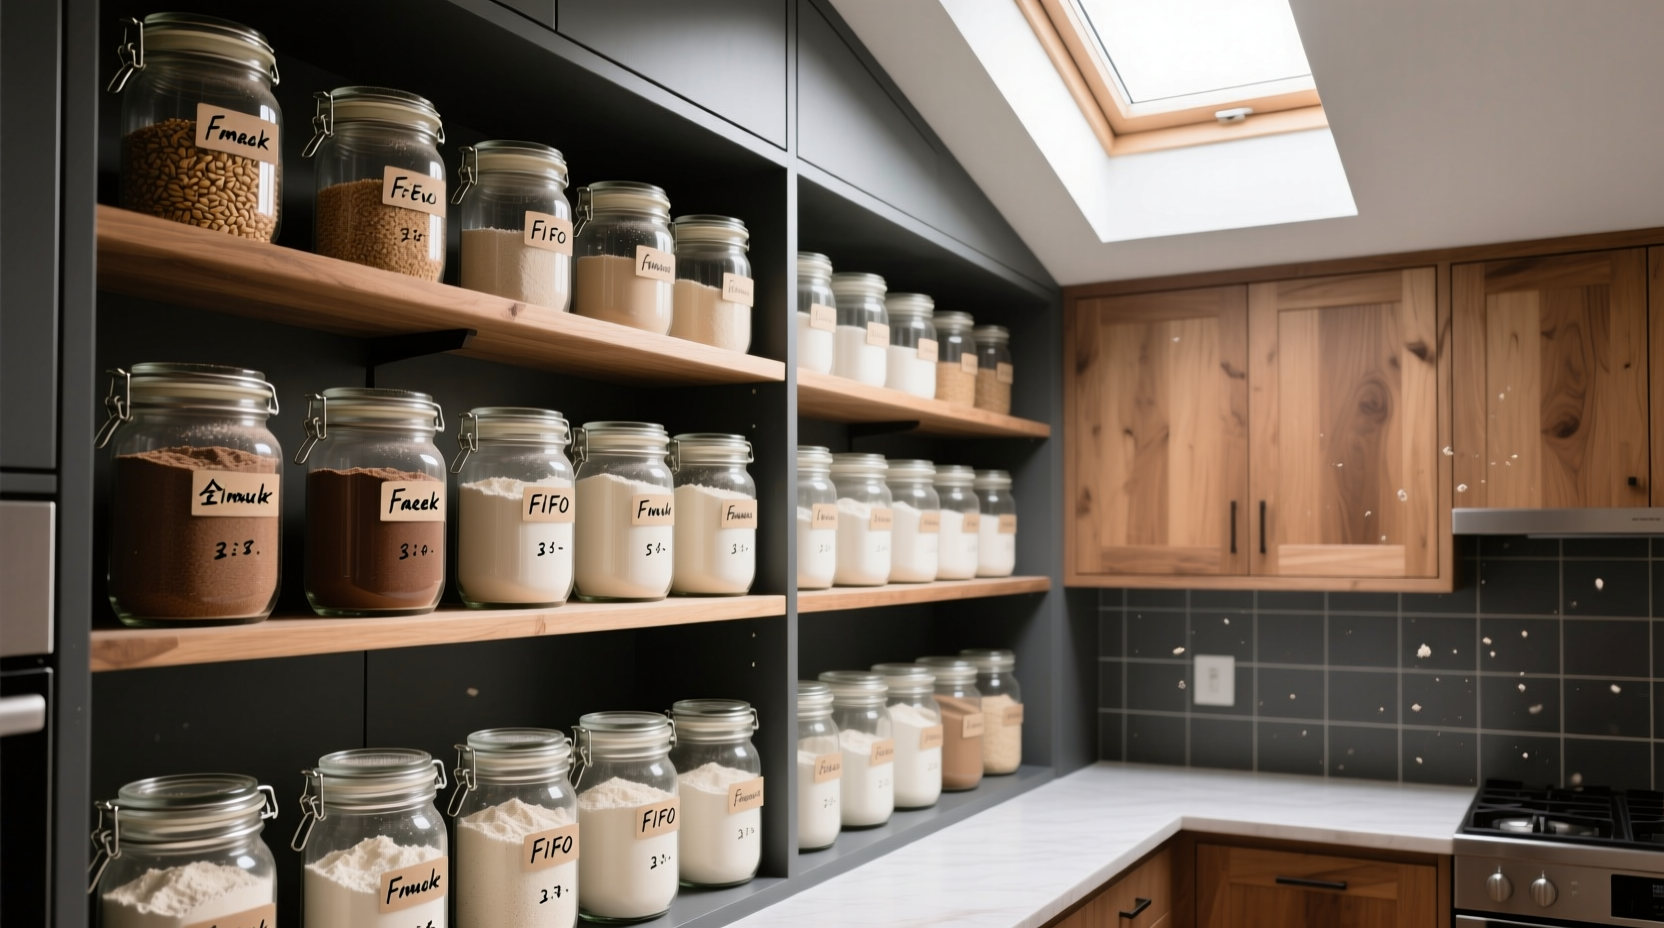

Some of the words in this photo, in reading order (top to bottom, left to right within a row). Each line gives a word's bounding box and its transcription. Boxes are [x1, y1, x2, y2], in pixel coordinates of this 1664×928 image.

[531, 220, 566, 244] FIFO
[529, 494, 569, 514] FIFO
[642, 807, 675, 832] FIFO
[531, 836, 572, 864] FIFO
